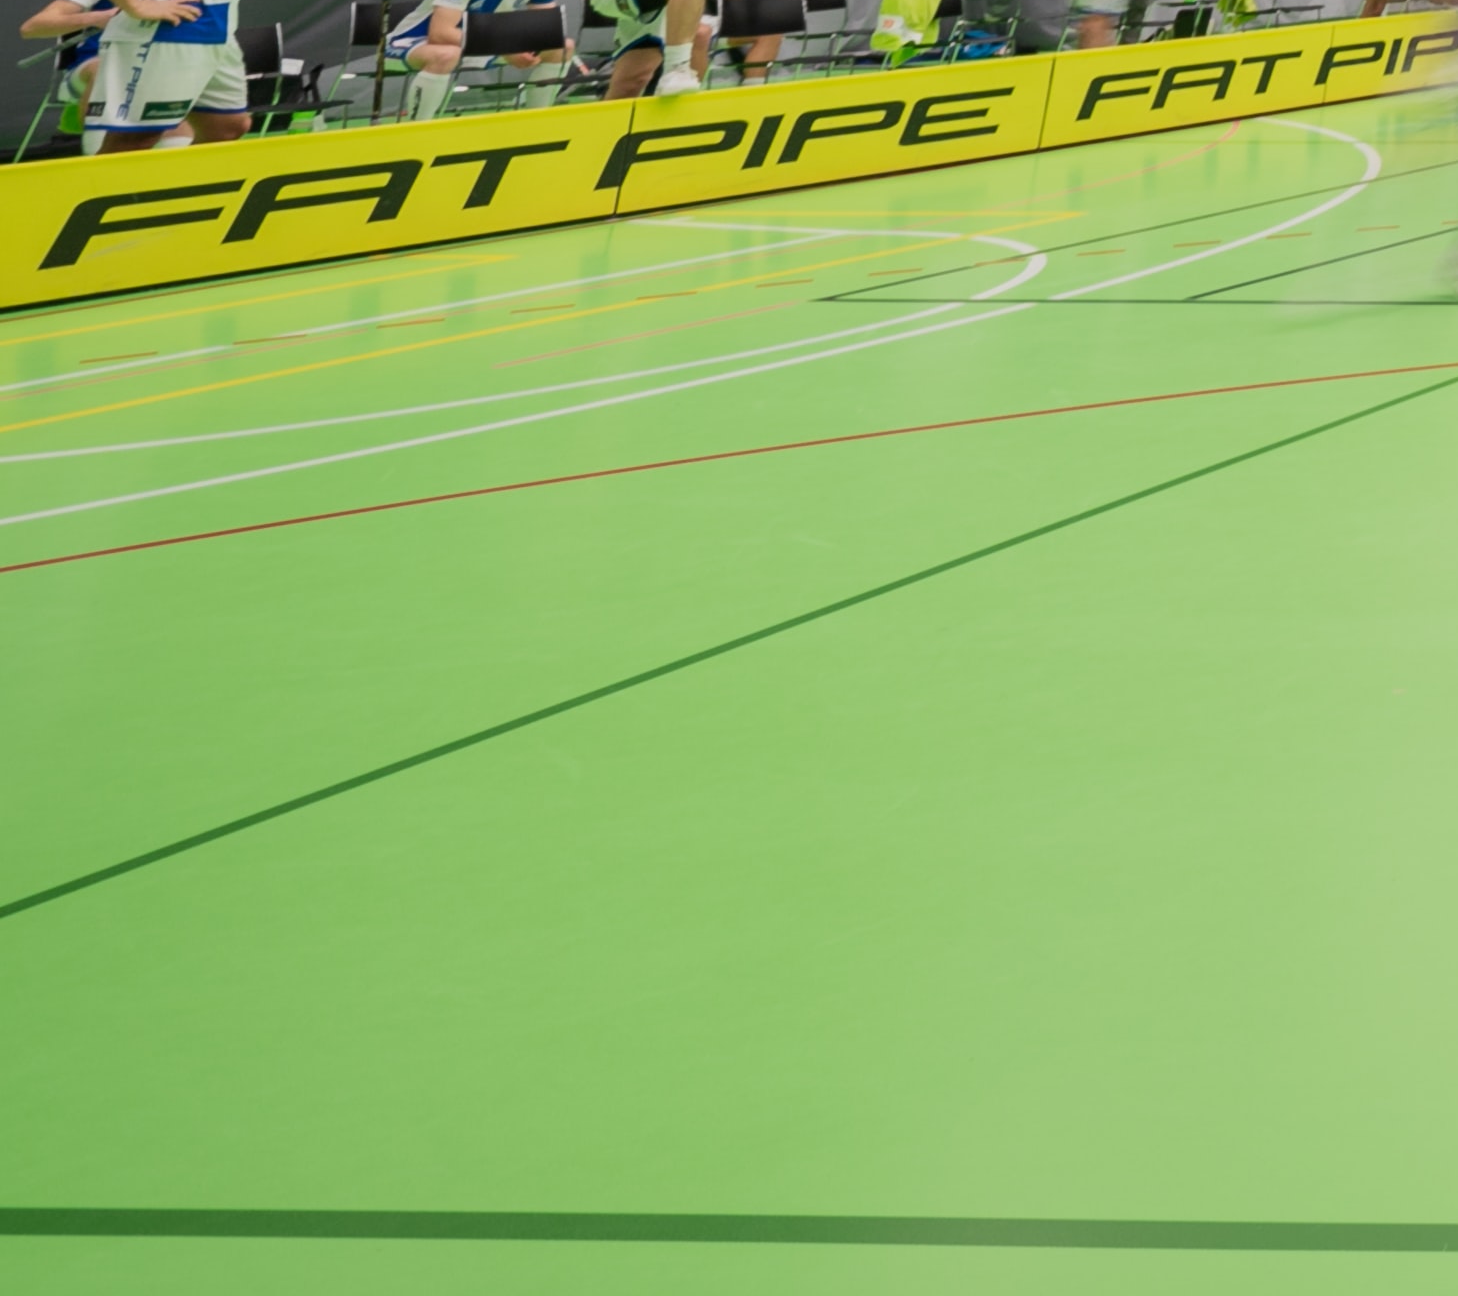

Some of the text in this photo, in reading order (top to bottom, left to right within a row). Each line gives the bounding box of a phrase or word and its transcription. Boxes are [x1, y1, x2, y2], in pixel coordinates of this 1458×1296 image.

[1076, 50, 1303, 120] FAT
[37, 86, 1014, 270] FAT PIPE
